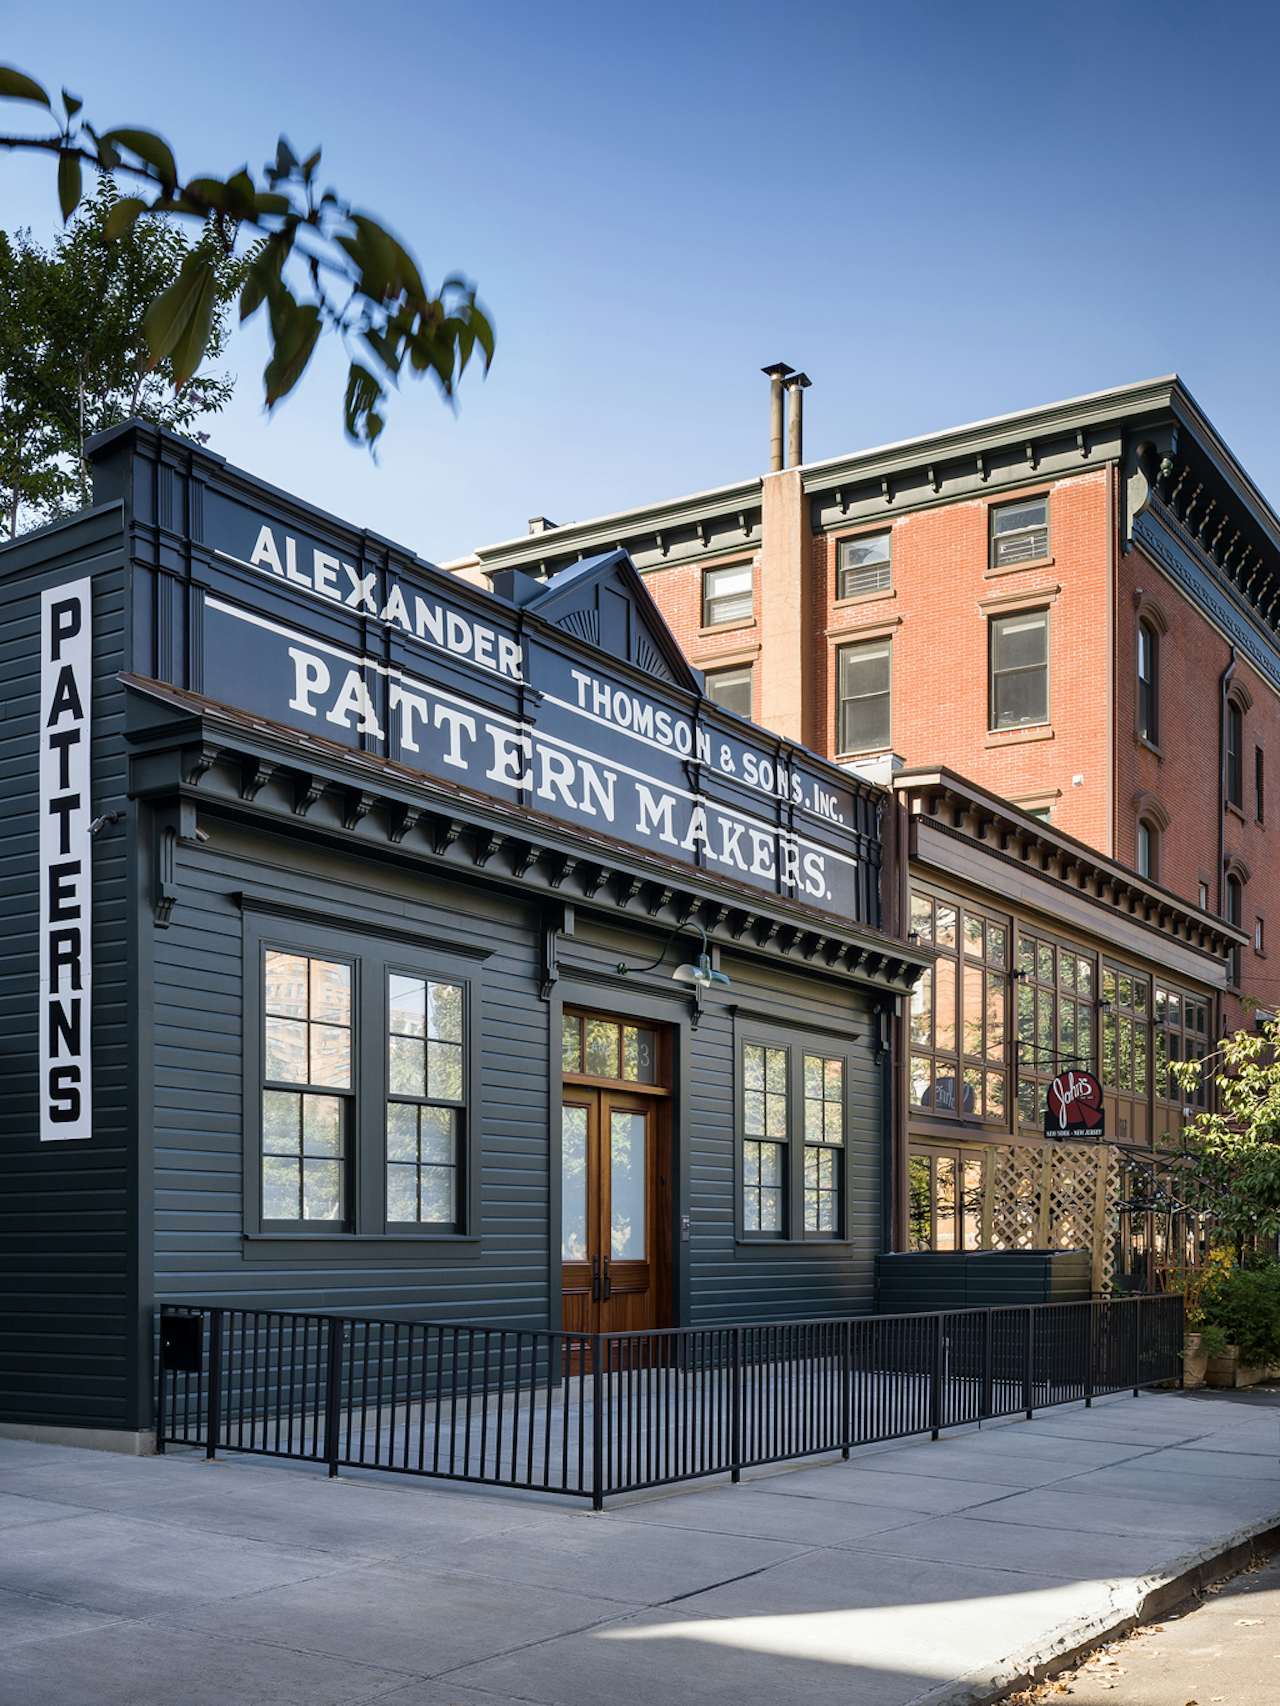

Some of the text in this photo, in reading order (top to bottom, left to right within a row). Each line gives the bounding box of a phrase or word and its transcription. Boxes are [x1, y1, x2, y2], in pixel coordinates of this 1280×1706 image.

[250, 525, 523, 679] ALEXANDER
[571, 669, 711, 765] THOMSON
[720, 745, 736, 773] &
[814, 783, 844, 823] INC.
[288, 646, 832, 900] PATTERN MAKERS.
[46, 596, 84, 1123] PATTERNS
